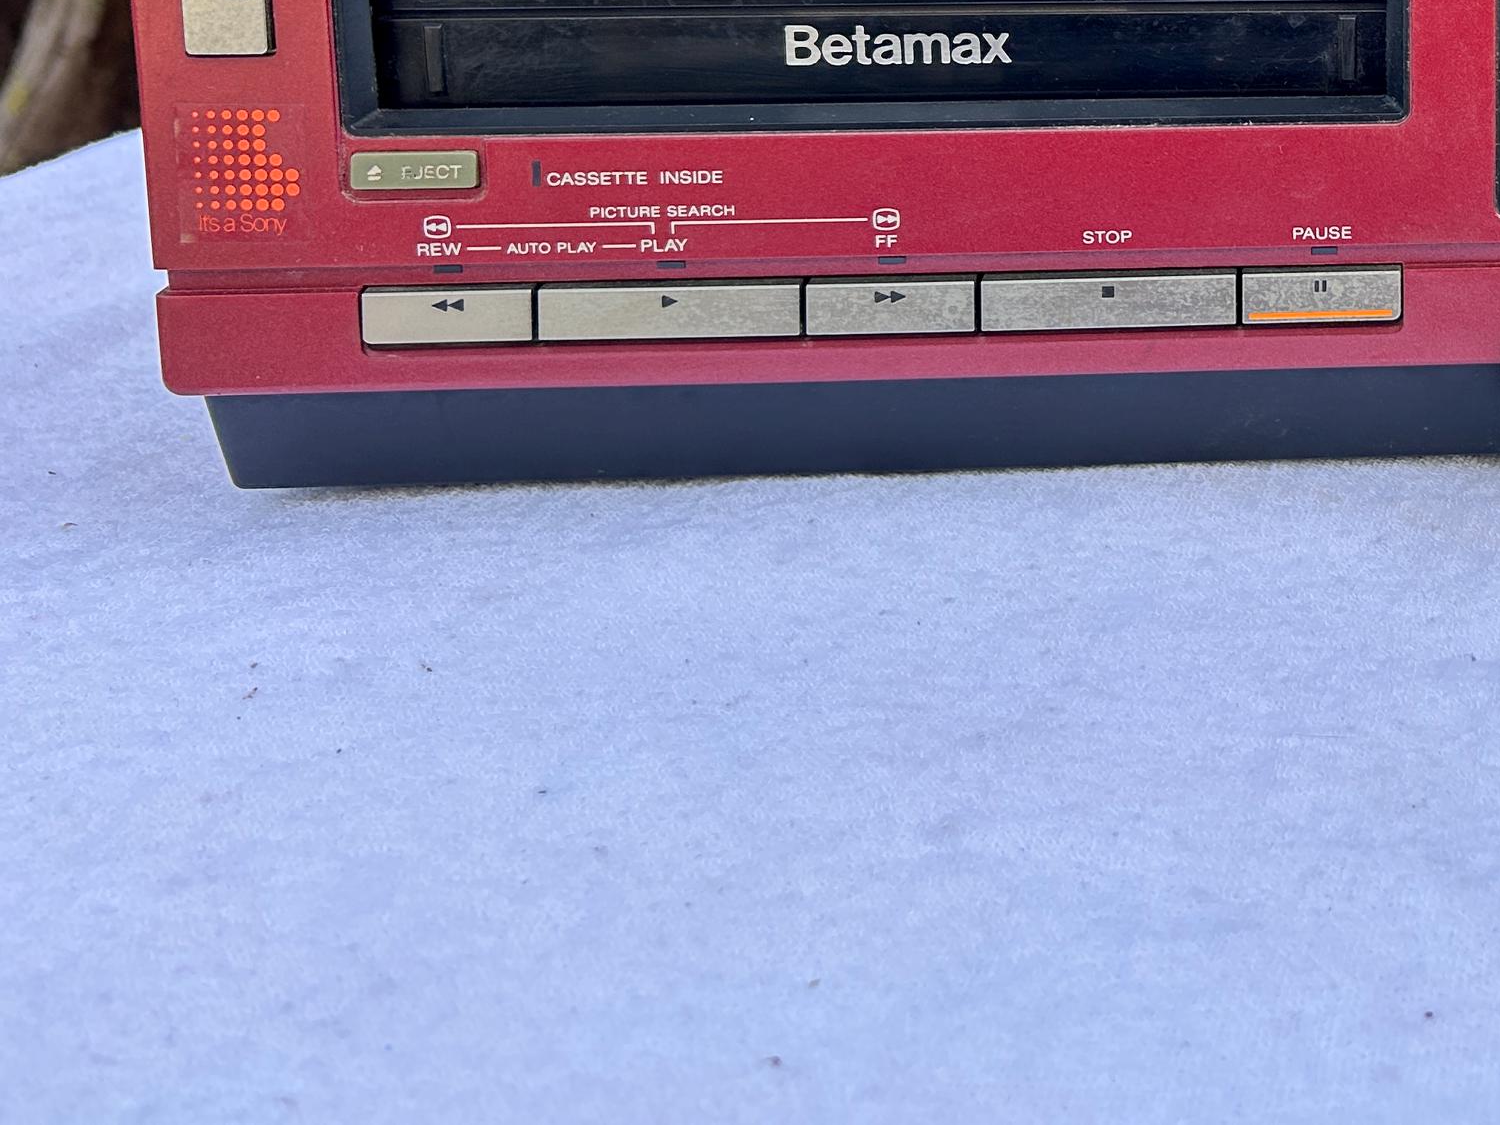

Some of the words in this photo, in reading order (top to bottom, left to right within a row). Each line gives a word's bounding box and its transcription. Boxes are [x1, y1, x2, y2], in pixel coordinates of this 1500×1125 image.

[785, 24, 1012, 66] Betamax
[546, 171, 648, 186] CASSETTE
[660, 170, 723, 185] INSIDE
[589, 205, 661, 219] PICTURE
[667, 204, 735, 218] SEARCH
[223, 217, 236, 232] a
[240, 213, 287, 236] Sony
[1082, 230, 1132, 244] STOP
[1292, 226, 1352, 240] PAUSE
[417, 242, 462, 257] REW
[507, 241, 551, 255] AUTO
[557, 241, 597, 254] PLAY
[640, 238, 688, 253] PLAY
[875, 235, 898, 248] FF
